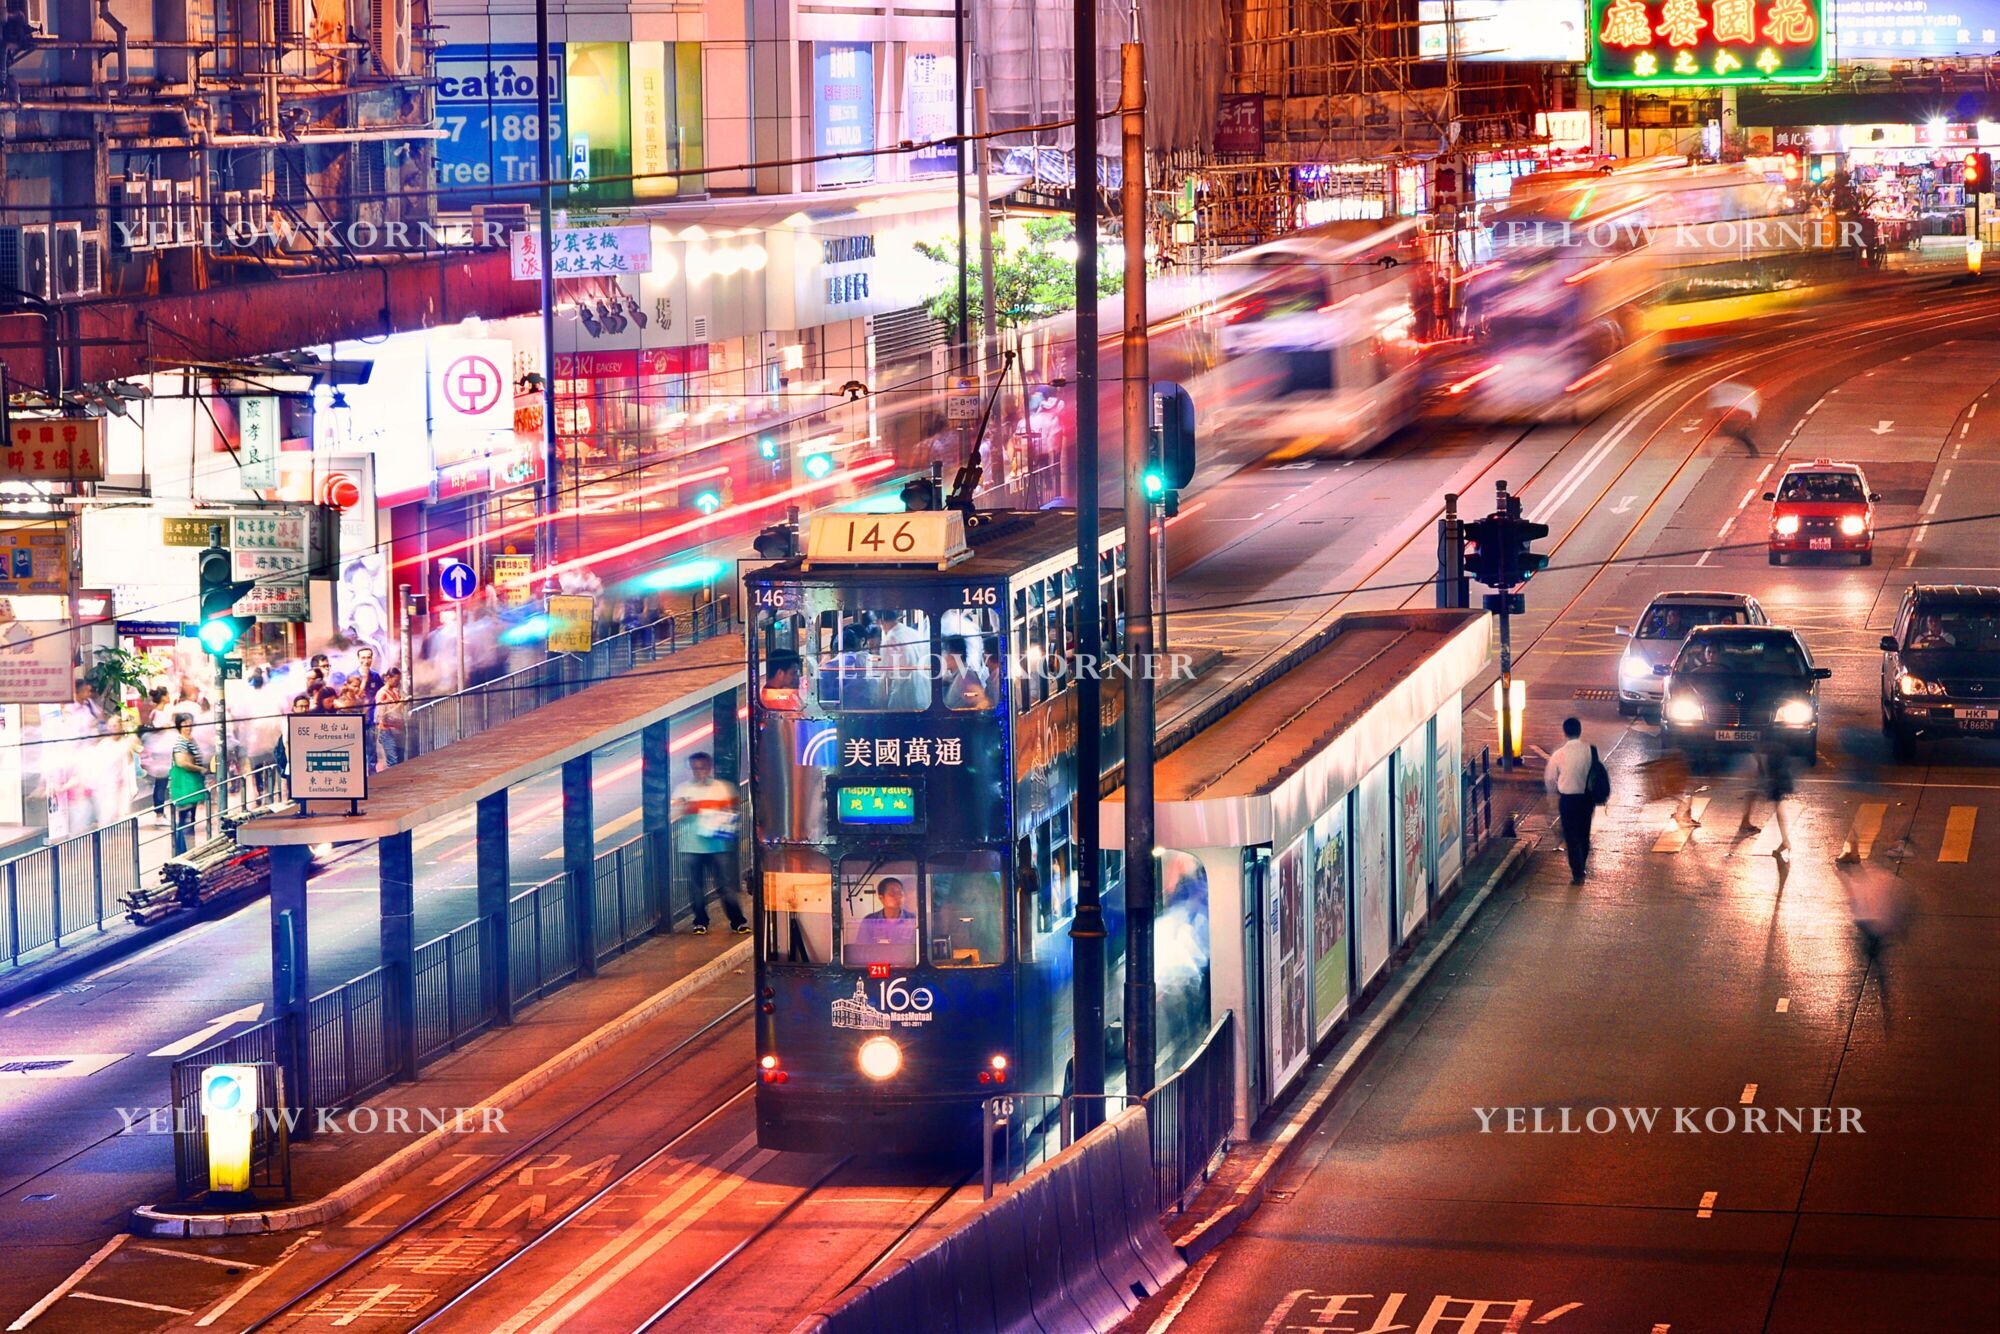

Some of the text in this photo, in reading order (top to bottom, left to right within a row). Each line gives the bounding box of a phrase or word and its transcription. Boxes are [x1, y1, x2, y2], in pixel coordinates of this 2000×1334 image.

[481, 115, 561, 142] 1885
[596, 362, 622, 374] BAKERY
[847, 521, 915, 553] 146
[754, 589, 784, 607] 146
[962, 587, 997, 605] 146
[1966, 710, 1988, 718] HKR
[297, 726, 310, 736] 65E
[320, 723, 349, 732] 炮台山
[1718, 731, 1730, 739] HA
[844, 737, 963, 767] 美國萬通
[310, 776, 348, 785] 東行站
[842, 787, 913, 797] Happy Valley
[850, 798, 908, 811] 跑馬地
[871, 966, 887, 975] Z11
[880, 977, 934, 1011] 160
[890, 1012, 933, 1021] MassMutual
[427, 1153, 711, 1187] TRAM
[342, 1193, 659, 1230] LANE
